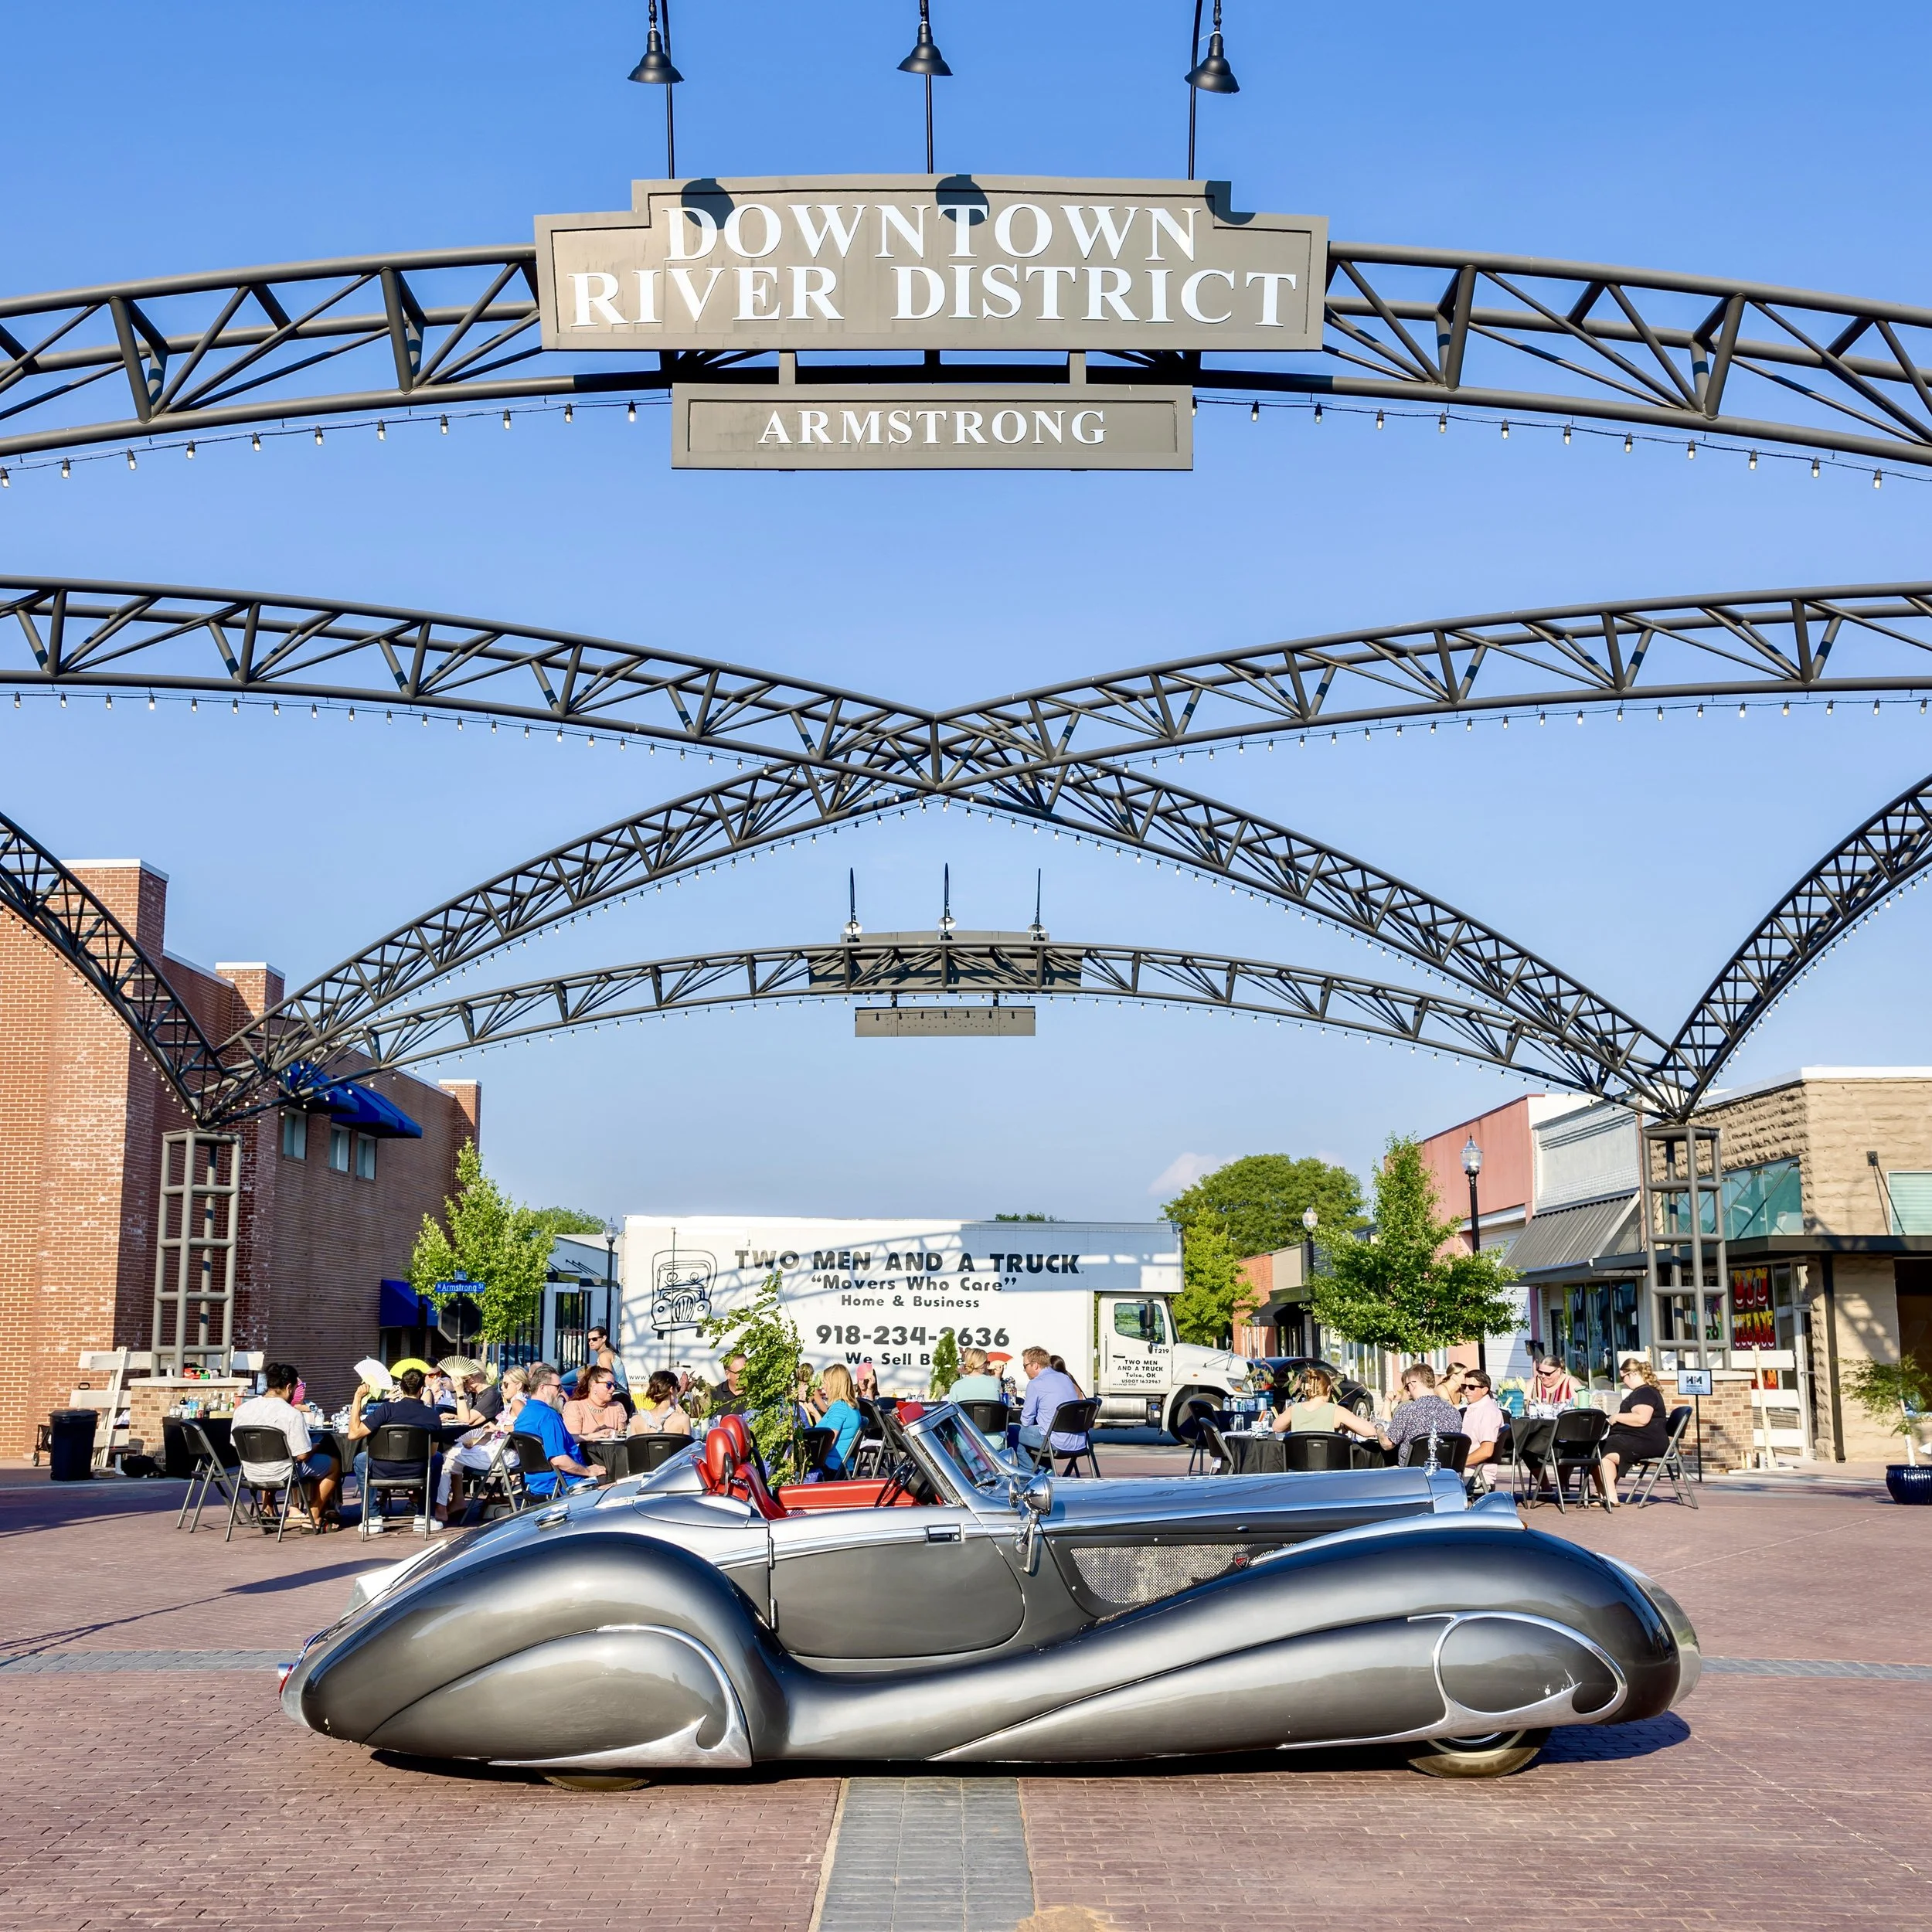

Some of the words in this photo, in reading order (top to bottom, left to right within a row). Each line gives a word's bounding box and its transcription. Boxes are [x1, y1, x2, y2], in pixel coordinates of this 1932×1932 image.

[662, 203, 1201, 260] DOWNTOWN
[567, 266, 845, 328] RIVER
[890, 264, 1297, 327] DISTRICT
[757, 409, 1107, 445] ARMSTRONG
[735, 1250, 799, 1270] TWO
[813, 1250, 871, 1270] MEN
[885, 1251, 943, 1271] AND
[957, 1252, 975, 1272] A
[990, 1253, 1080, 1274] TRUCK
[906, 1276, 950, 1291] Who
[841, 1294, 884, 1306] Home
[893, 1294, 904, 1306] &
[913, 1295, 980, 1308] Business
[845, 1352, 872, 1365] We
[881, 1352, 912, 1366] Sell
